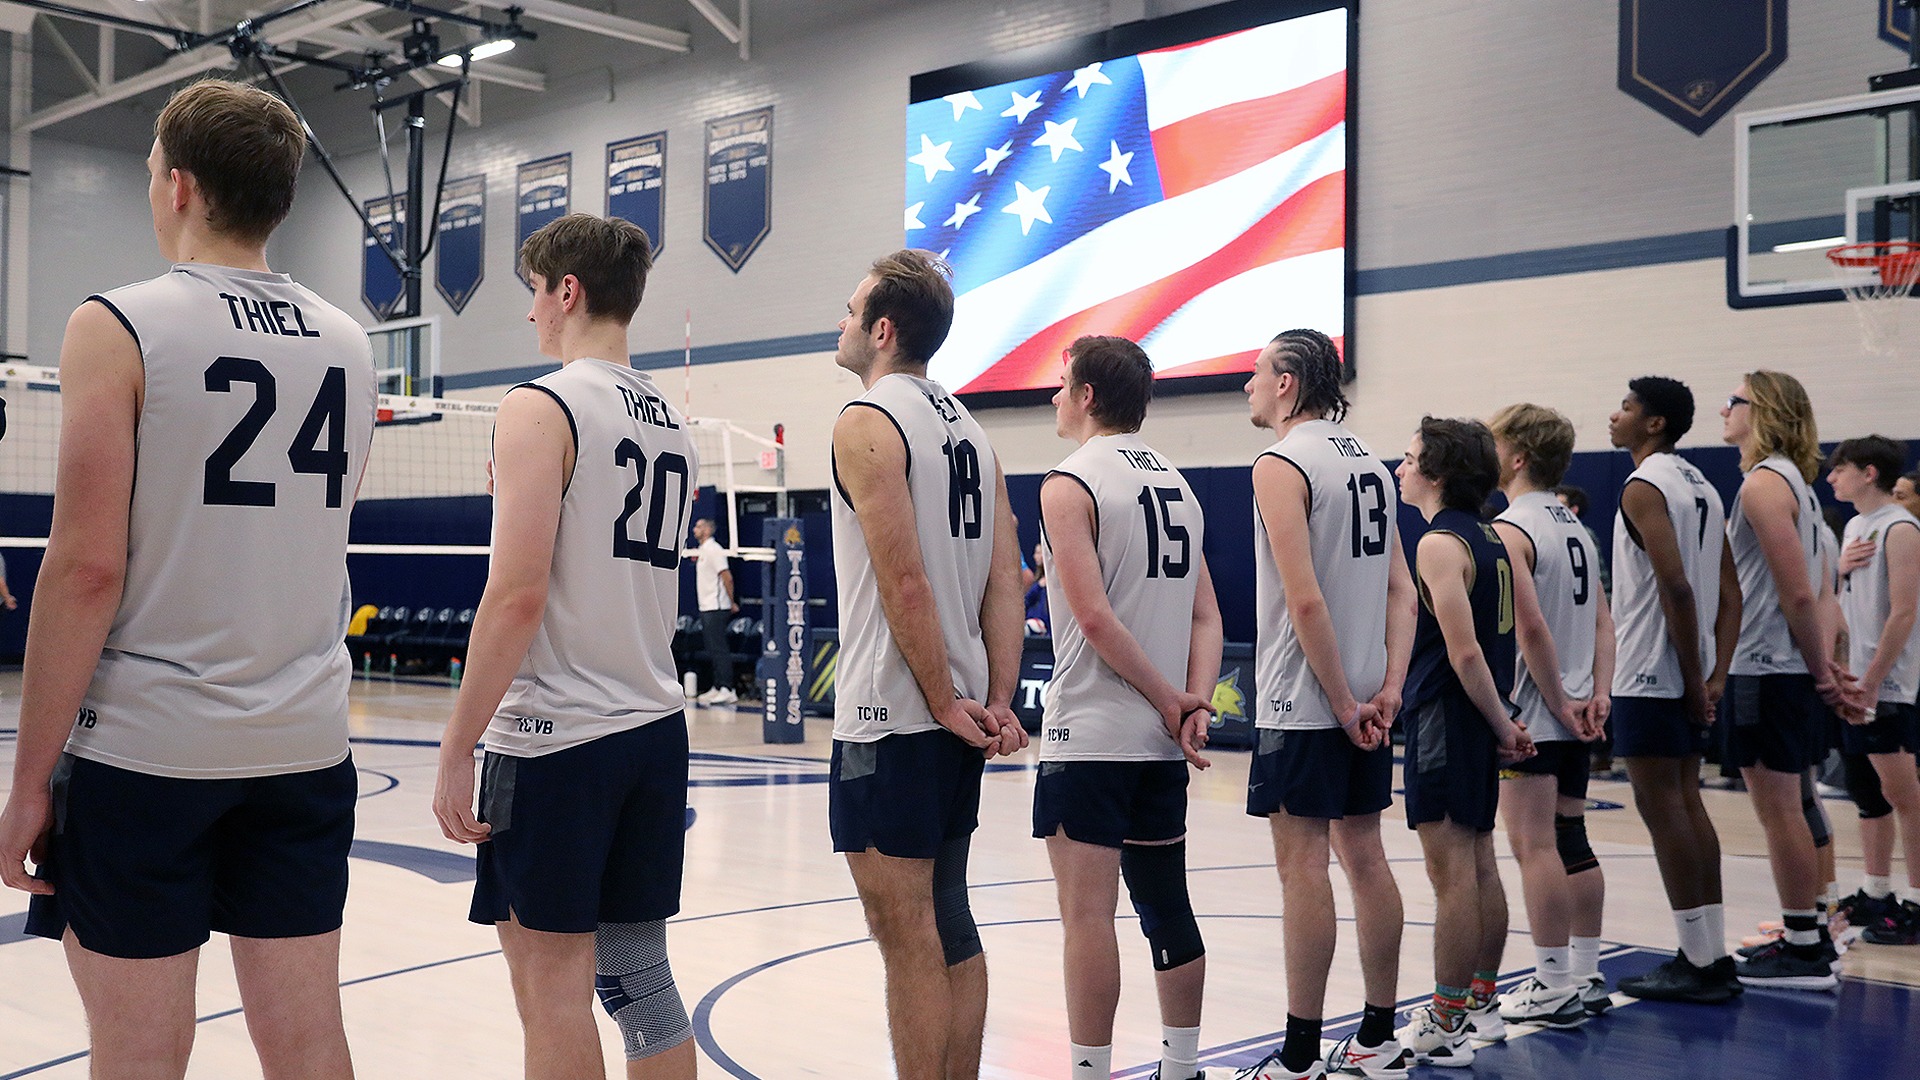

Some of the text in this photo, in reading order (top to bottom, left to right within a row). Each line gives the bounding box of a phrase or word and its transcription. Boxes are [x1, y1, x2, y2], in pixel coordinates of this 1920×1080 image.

[219, 293, 321, 337] THIEL
[616, 385, 680, 430] THIEL
[203, 356, 349, 509] 24
[1328, 437, 1369, 457] THIEL
[1117, 449, 1168, 472] THIEL
[613, 437, 689, 570] 20
[942, 435, 982, 539] 18
[1137, 486, 1190, 578] 15
[1347, 472, 1388, 558] 13
[1695, 496, 1709, 551] 7
[1567, 537, 1589, 605] 9
[786, 550, 805, 725] TOMCATS
[78, 706, 98, 729] VB
[515, 717, 554, 735] TCVB
[857, 706, 888, 722] TCVB
[1271, 700, 1292, 712] TCVB
[1048, 728, 1070, 741] TCVB
